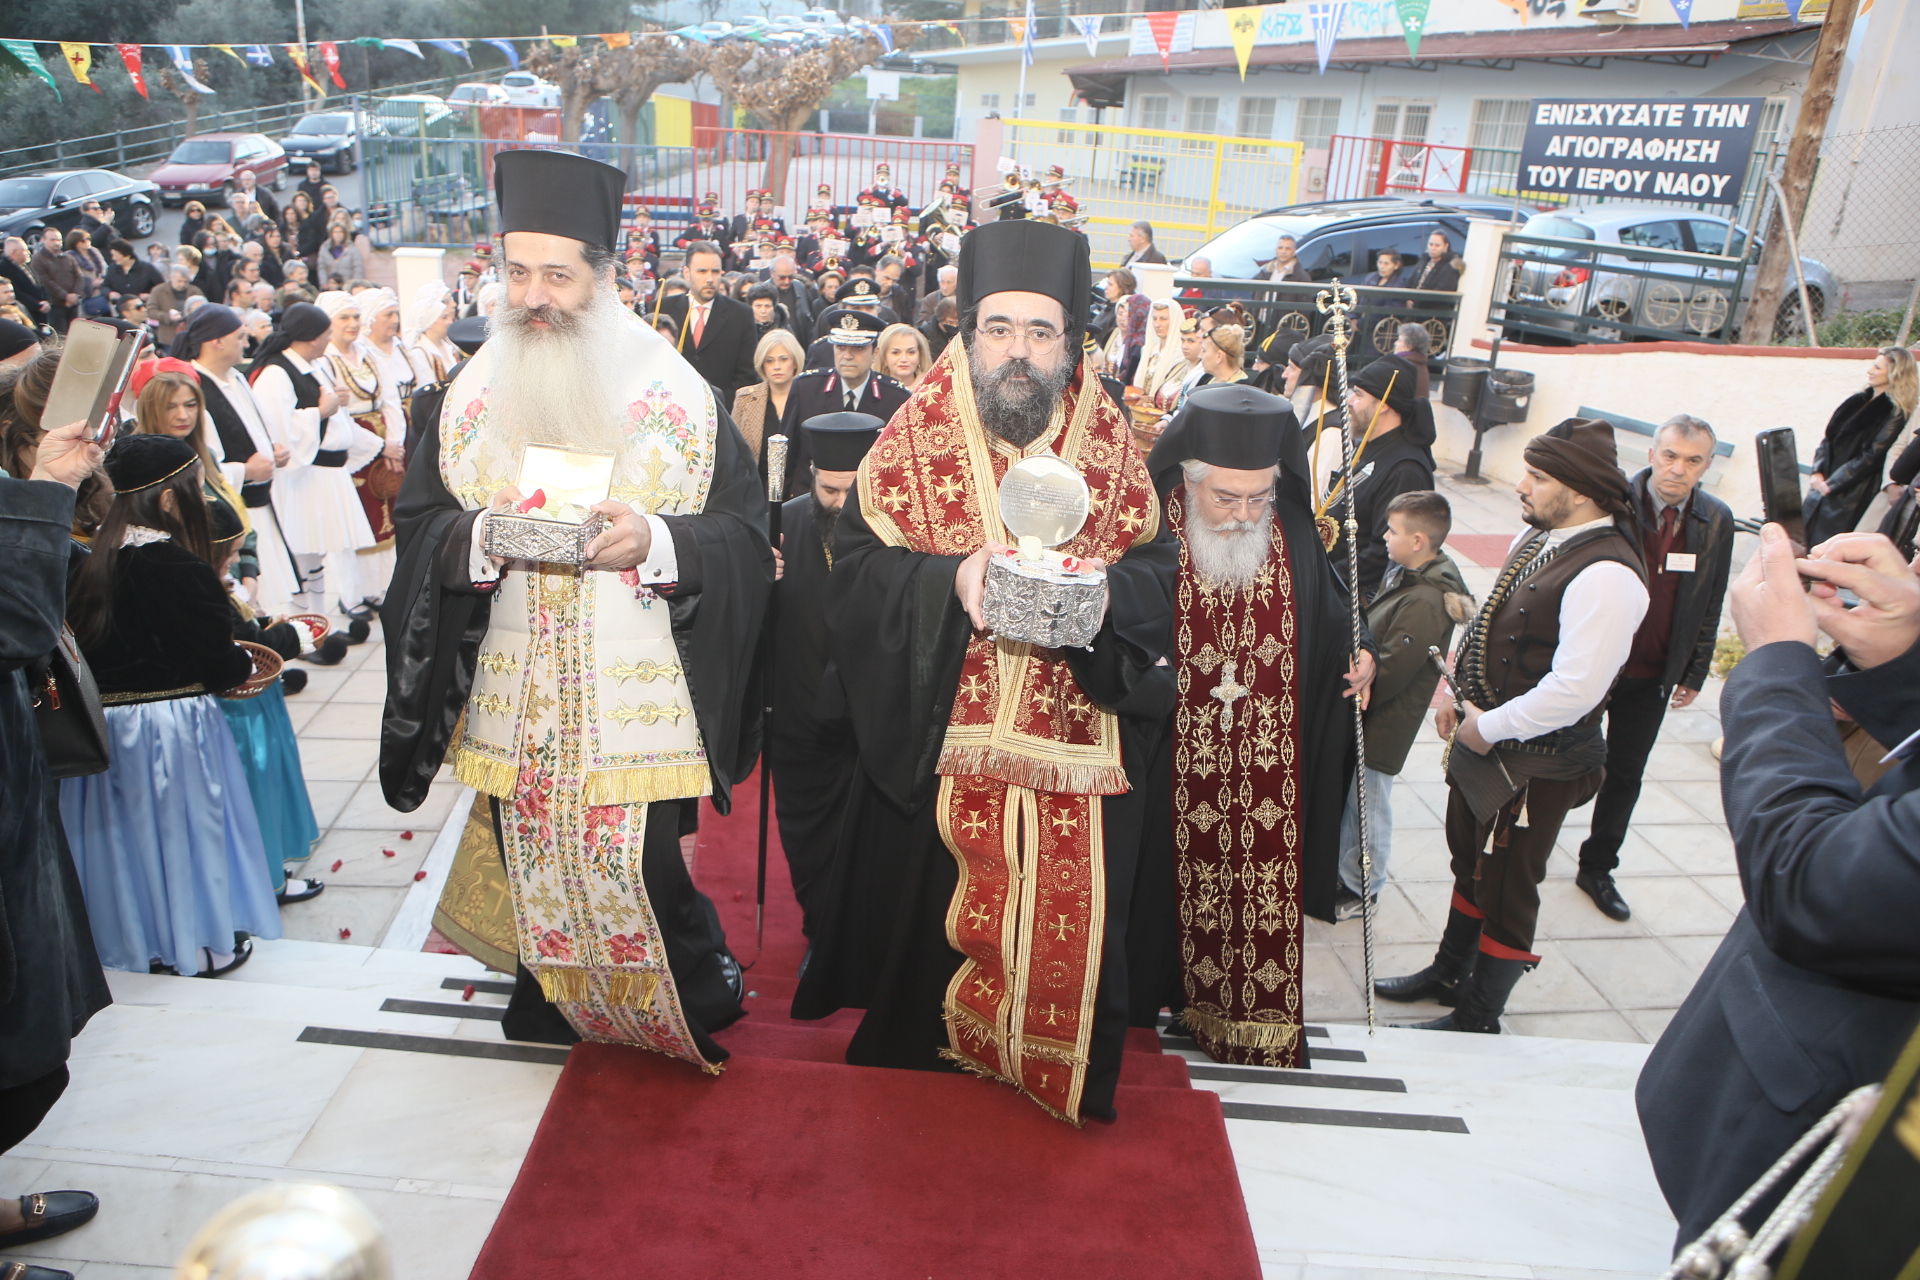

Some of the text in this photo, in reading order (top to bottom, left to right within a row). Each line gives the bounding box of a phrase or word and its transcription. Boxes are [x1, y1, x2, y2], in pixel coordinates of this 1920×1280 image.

[1535, 104, 1750, 128] ΕΝΙΣΧΥΣΑΤΕ ΤΗΝ
[1545, 135, 1721, 163] ΑΓΙΟΓΡΑΦΗΣΗ
[1527, 165, 1731, 198] ΤΟΥ ΙΕΡΟΥ ΝΑΟΥ
